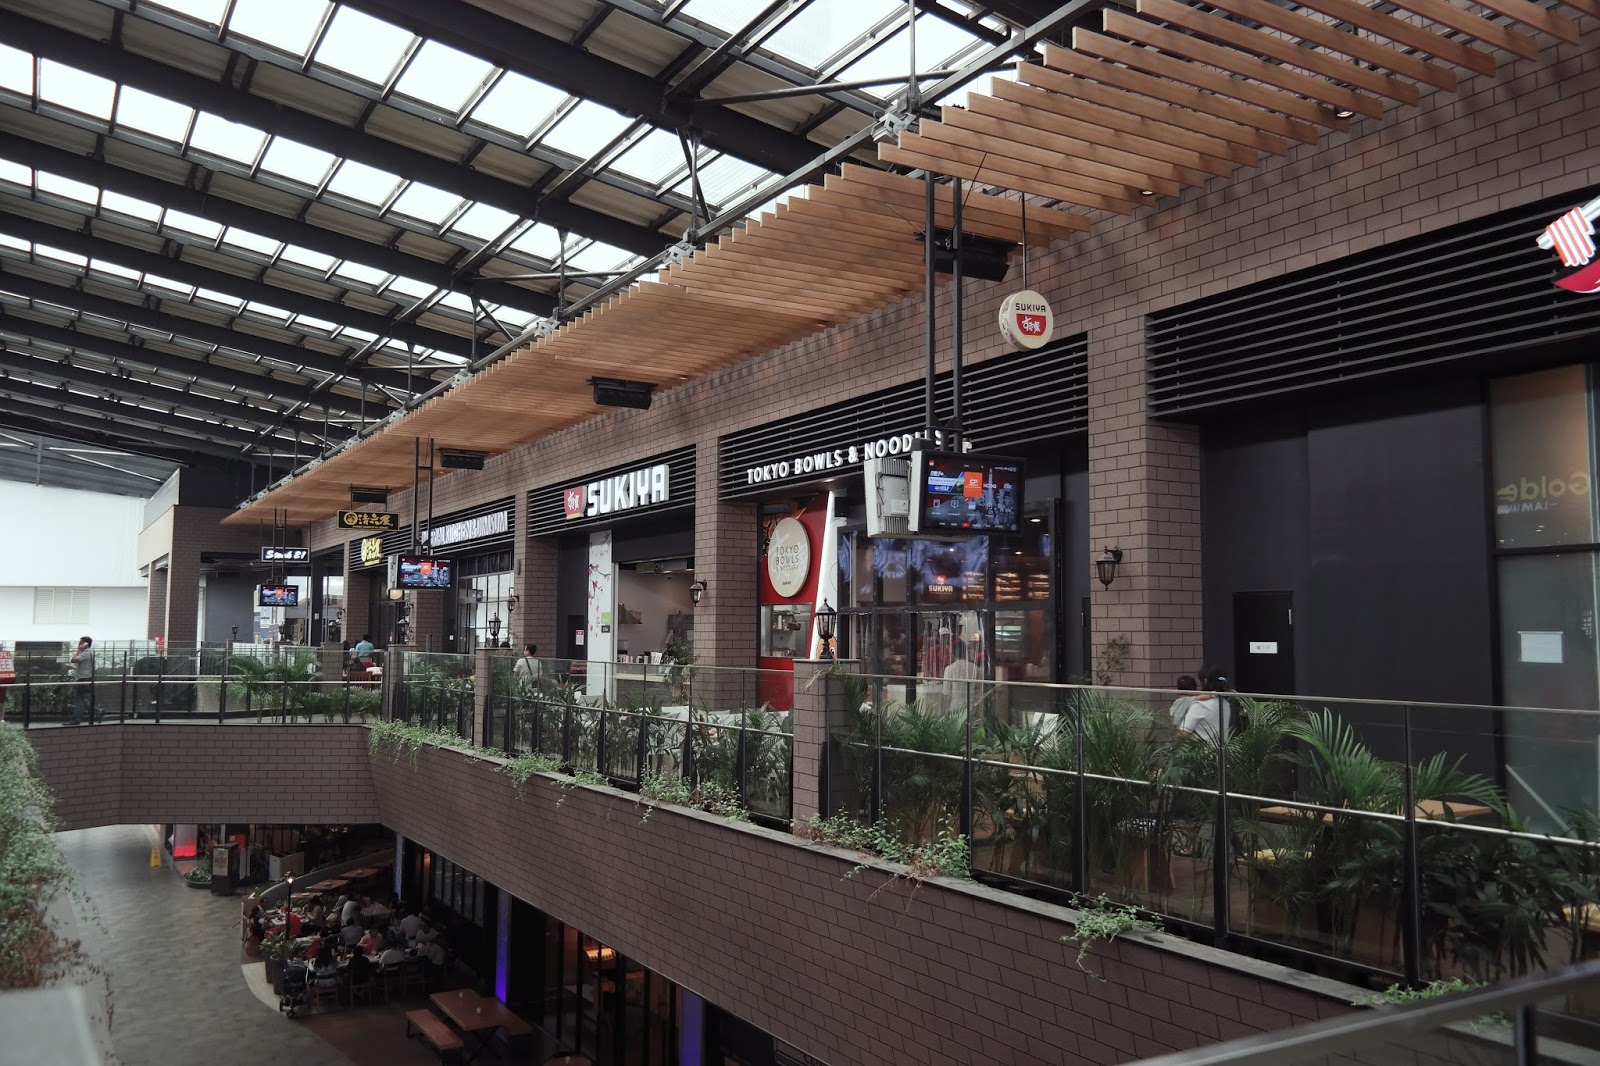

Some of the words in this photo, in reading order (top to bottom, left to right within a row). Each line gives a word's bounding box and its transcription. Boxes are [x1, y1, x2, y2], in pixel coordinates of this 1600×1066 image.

[1015, 302, 1046, 313] SUKIYA
[747, 461, 790, 484] TOKYO
[794, 449, 844, 475] BOWLS
[847, 446, 859, 463] &
[864, 430, 942, 460] NOODS
[587, 464, 670, 517] SUKIYA
[776, 544, 799, 556] TOKYO
[775, 555, 799, 565] BOWLS
